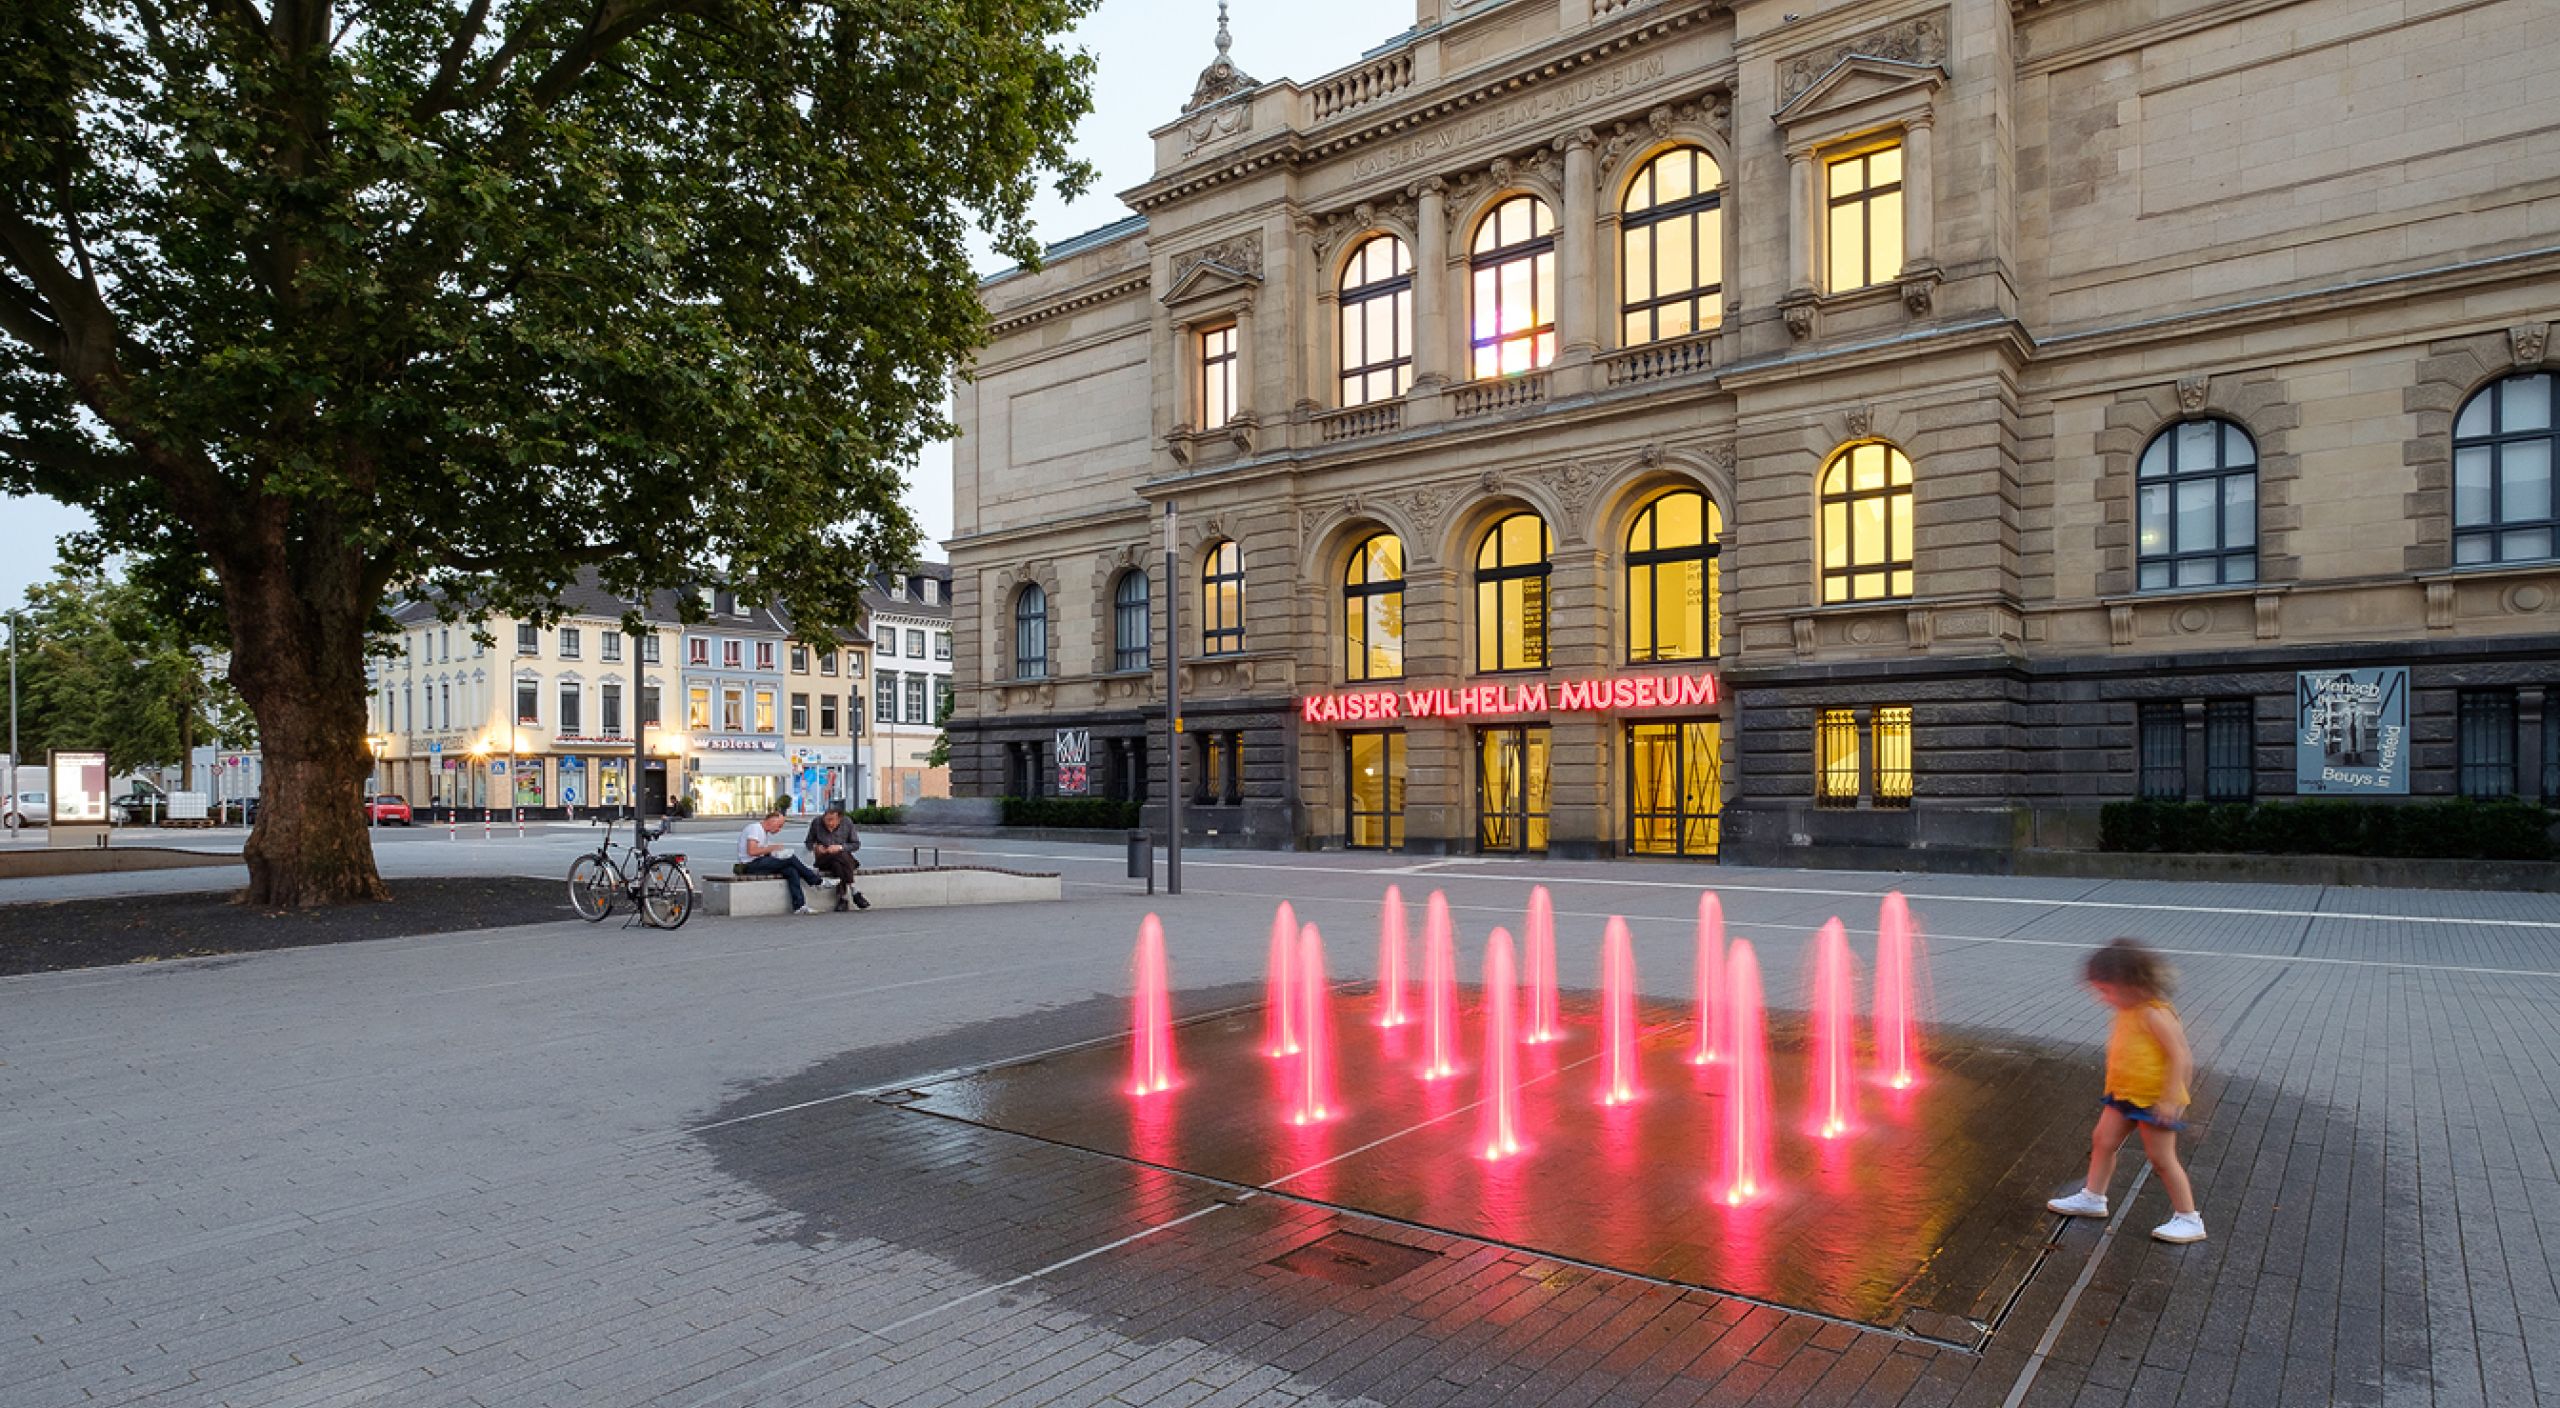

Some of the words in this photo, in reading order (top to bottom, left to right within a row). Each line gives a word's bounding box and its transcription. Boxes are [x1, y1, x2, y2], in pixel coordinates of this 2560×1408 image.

[1304, 690, 1399, 722] KAISER
[1406, 682, 1547, 717] WILHELM
[1560, 673, 1717, 711] MUSEUM
[2377, 725, 2401, 773] Krefeld
